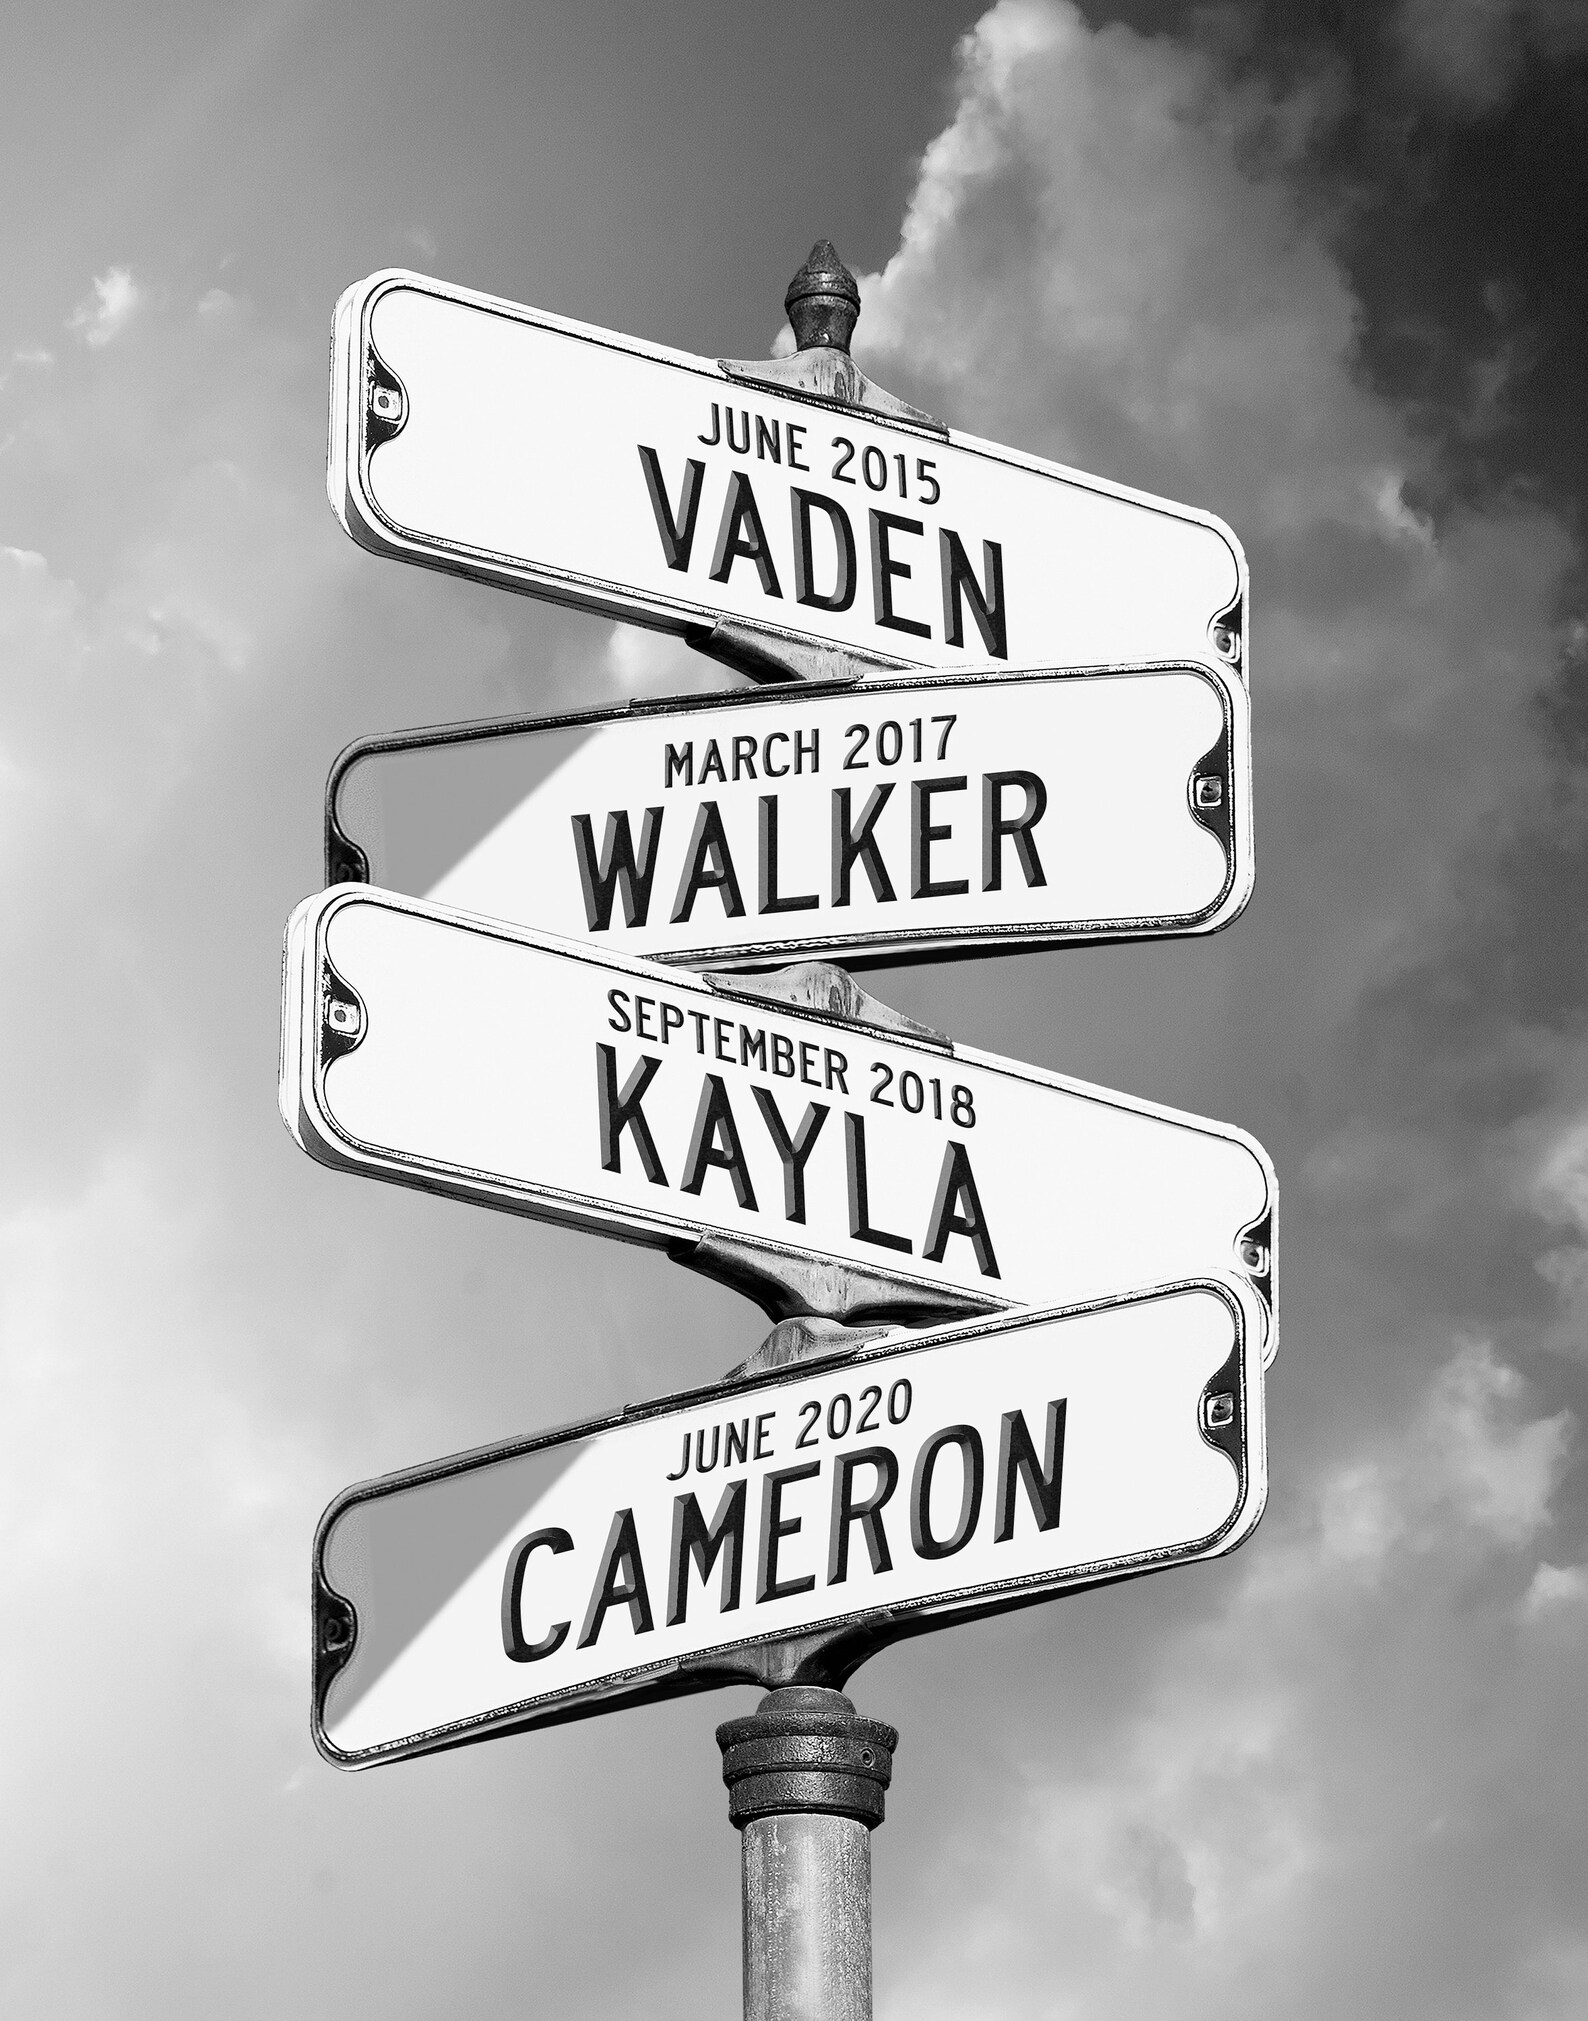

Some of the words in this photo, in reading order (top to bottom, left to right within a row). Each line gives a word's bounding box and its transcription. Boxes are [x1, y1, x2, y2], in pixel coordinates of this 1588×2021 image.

[697, 402, 810, 473] JUNE
[832, 436, 941, 506] 2015
[637, 444, 1008, 661] VADEN
[664, 729, 820, 789] MARCH
[842, 714, 957, 771] 2017
[571, 769, 1048, 933] WALKER
[607, 988, 850, 1096] SEPTEMBER
[870, 1061, 977, 1129] 2018
[596, 1041, 1002, 1281] KAYLA
[666, 1411, 776, 1482] JUNE
[795, 1378, 913, 1450] 2020
[500, 1397, 1068, 1664] CAMERON
